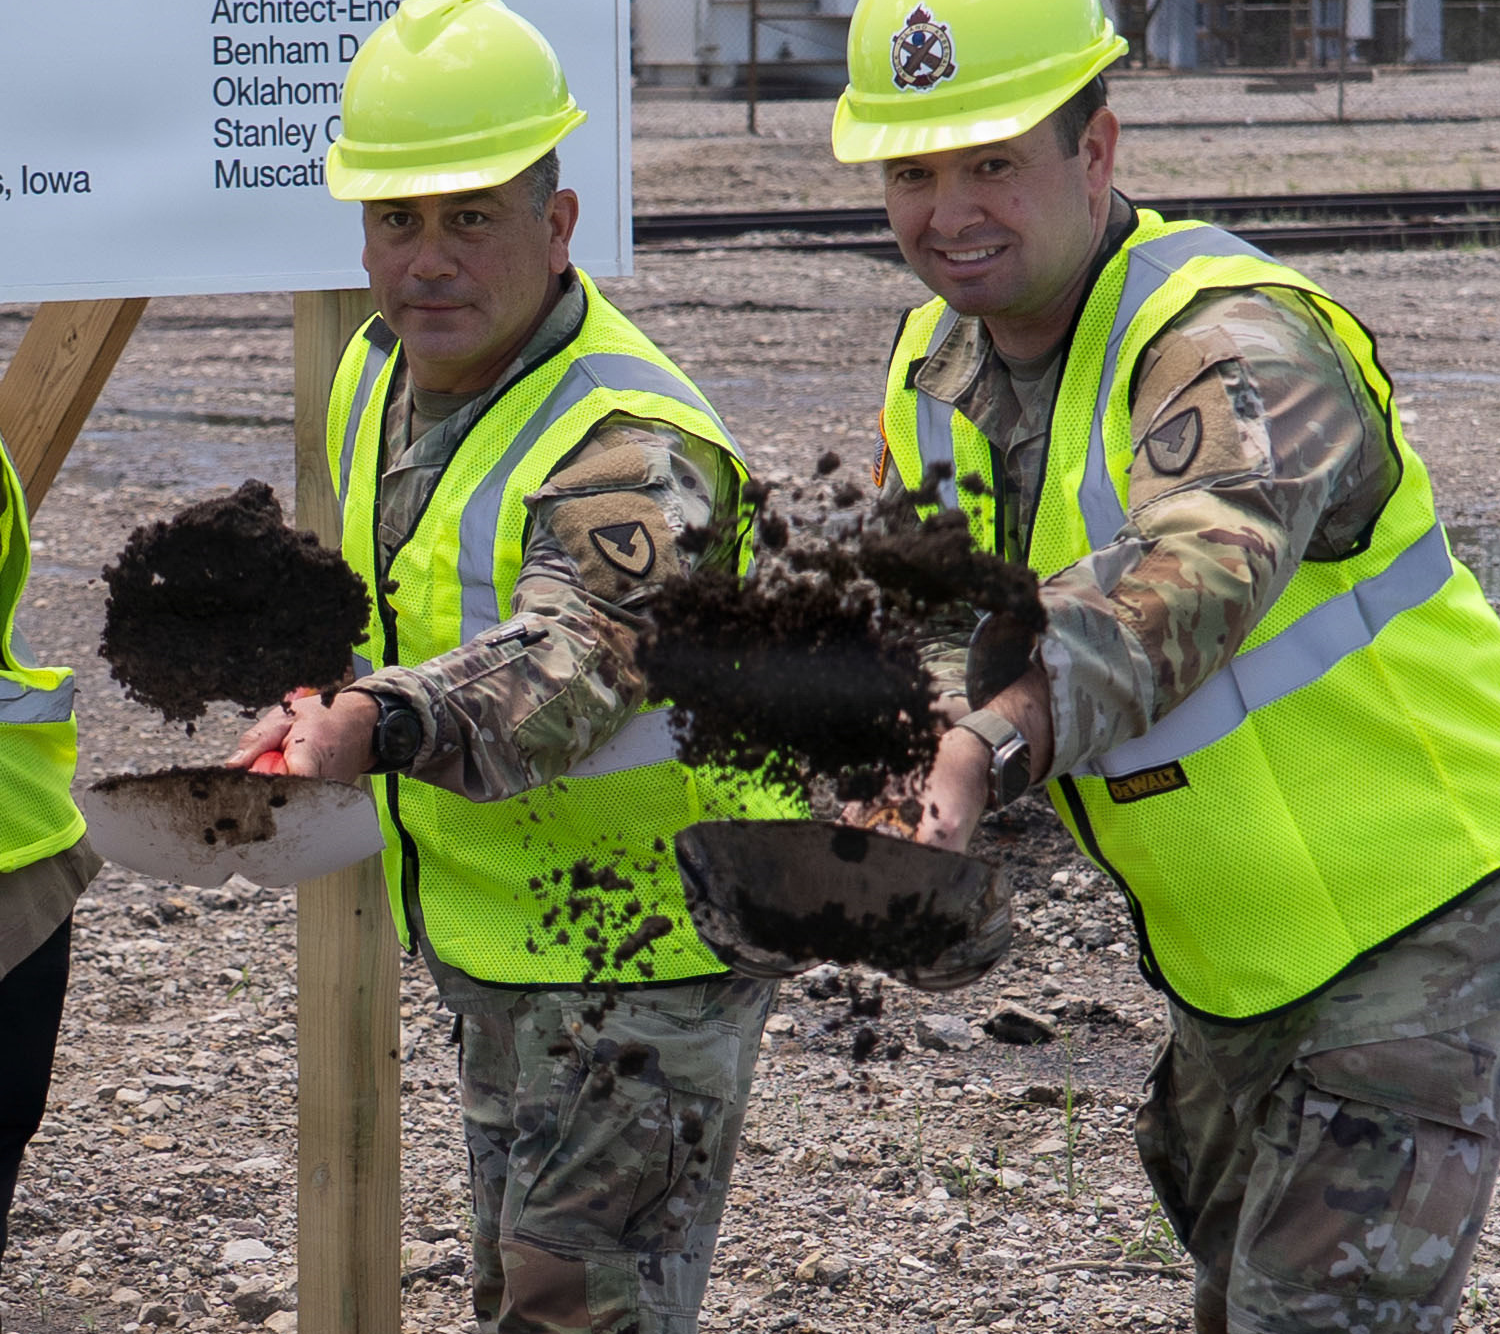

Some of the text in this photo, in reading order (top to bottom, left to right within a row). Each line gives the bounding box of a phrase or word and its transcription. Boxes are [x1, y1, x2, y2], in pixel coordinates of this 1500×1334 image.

[213, 34, 330, 65] Benham
[213, 116, 317, 154] Stanley
[21, 164, 92, 195] Iowa
[214, 156, 328, 189] Muscati
